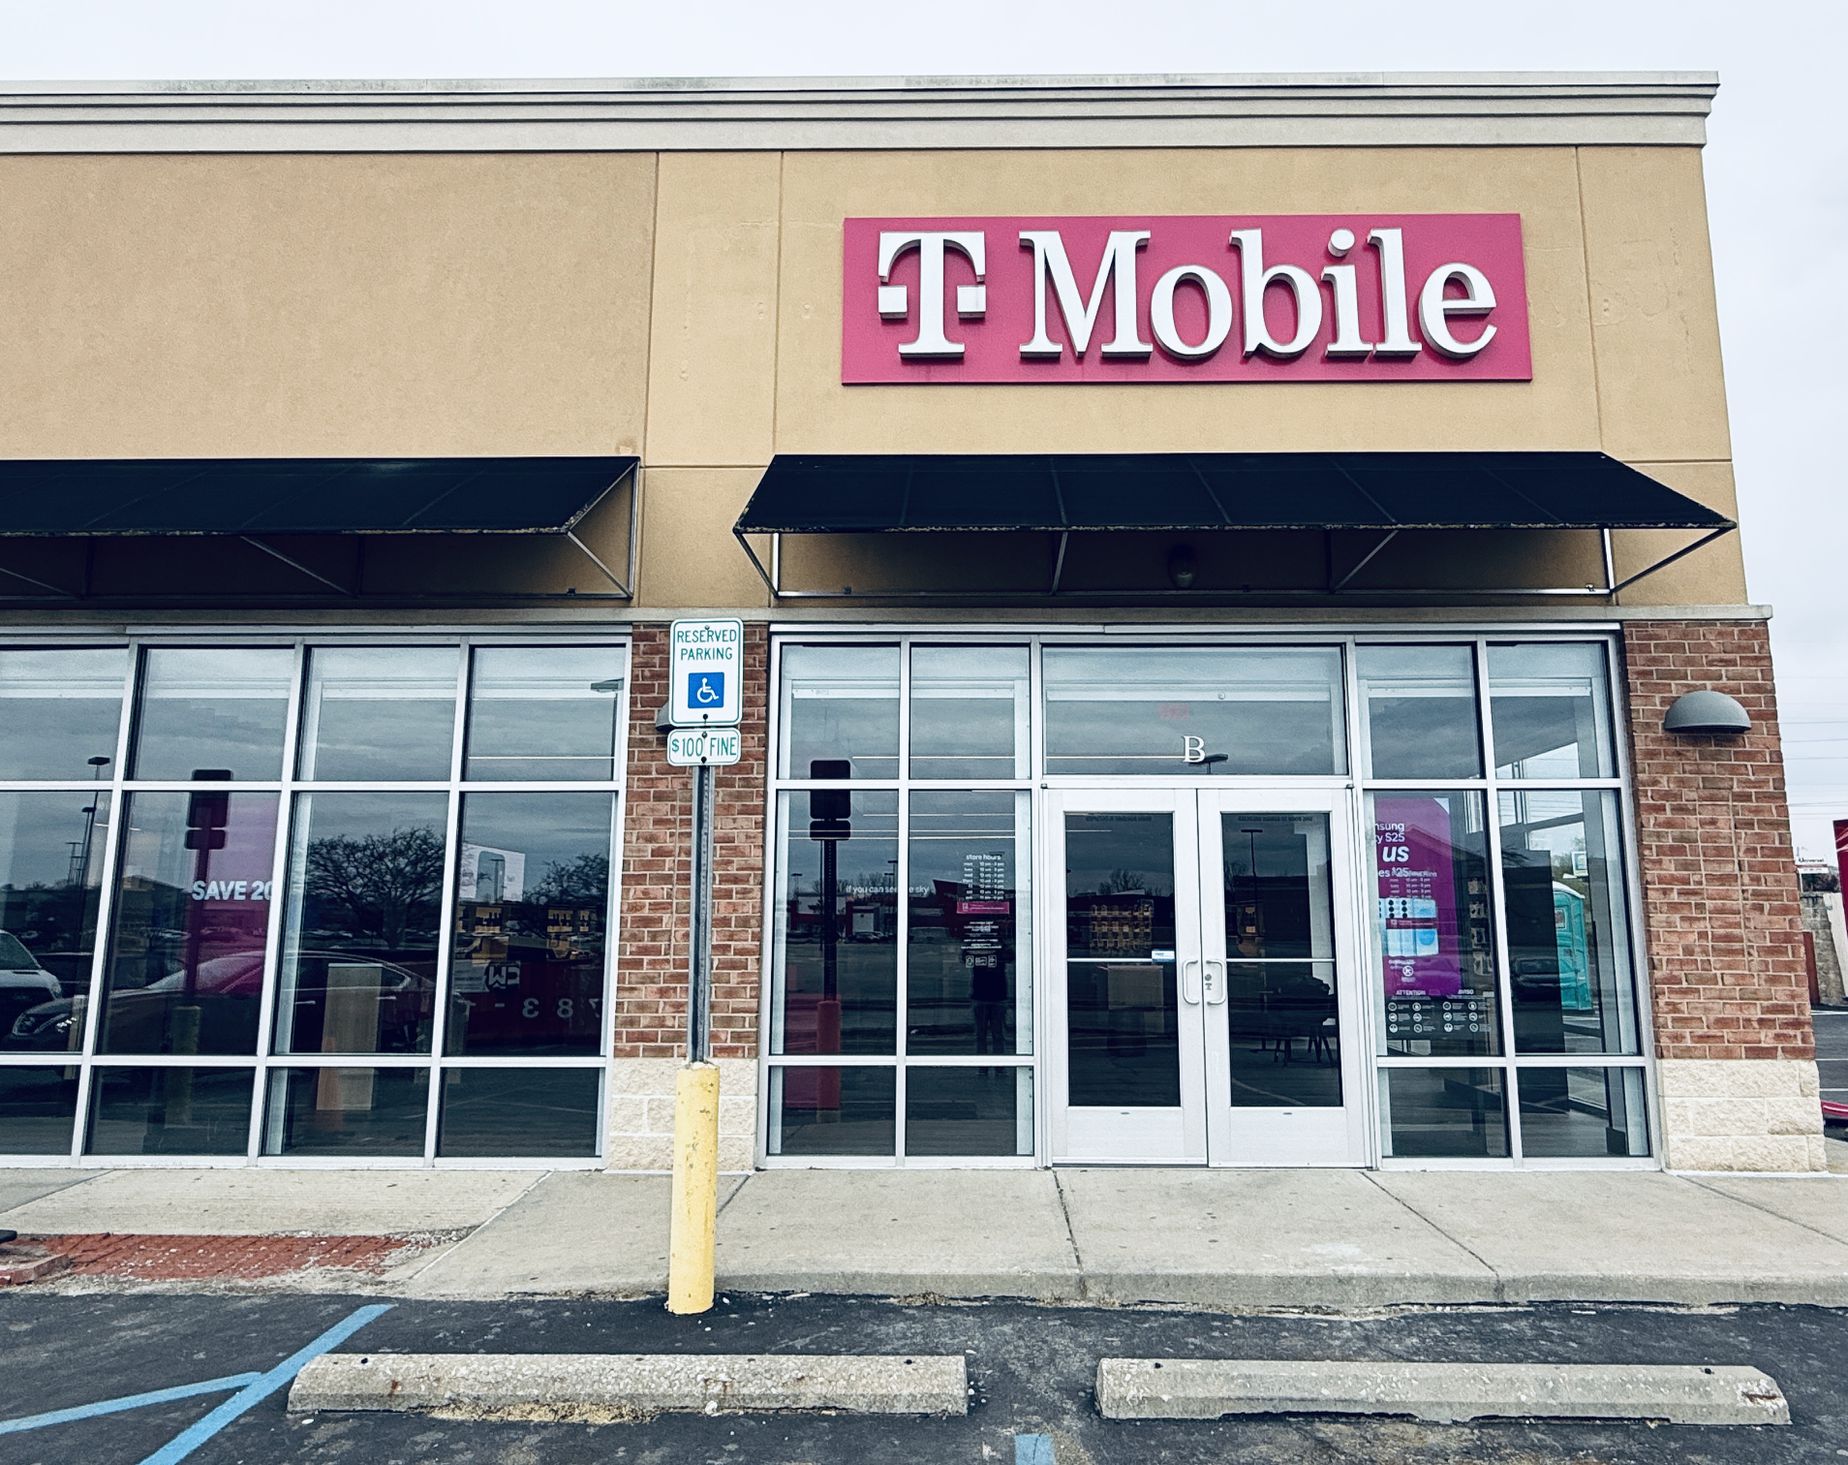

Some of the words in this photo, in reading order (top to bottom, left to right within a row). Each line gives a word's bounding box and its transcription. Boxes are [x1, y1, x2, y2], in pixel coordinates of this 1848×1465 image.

[877, 230, 987, 359] T
[1018, 228, 1498, 360] Mobile
[677, 629, 737, 643] RESERVED
[680, 647, 733, 660] PARKING
[671, 737, 703, 757] $100
[709, 737, 737, 756] FINE
[1183, 735, 1206, 763] B
[1385, 832, 1406, 843] S25
[191, 880, 247, 901] SAVE
[853, 886, 868, 896] you
